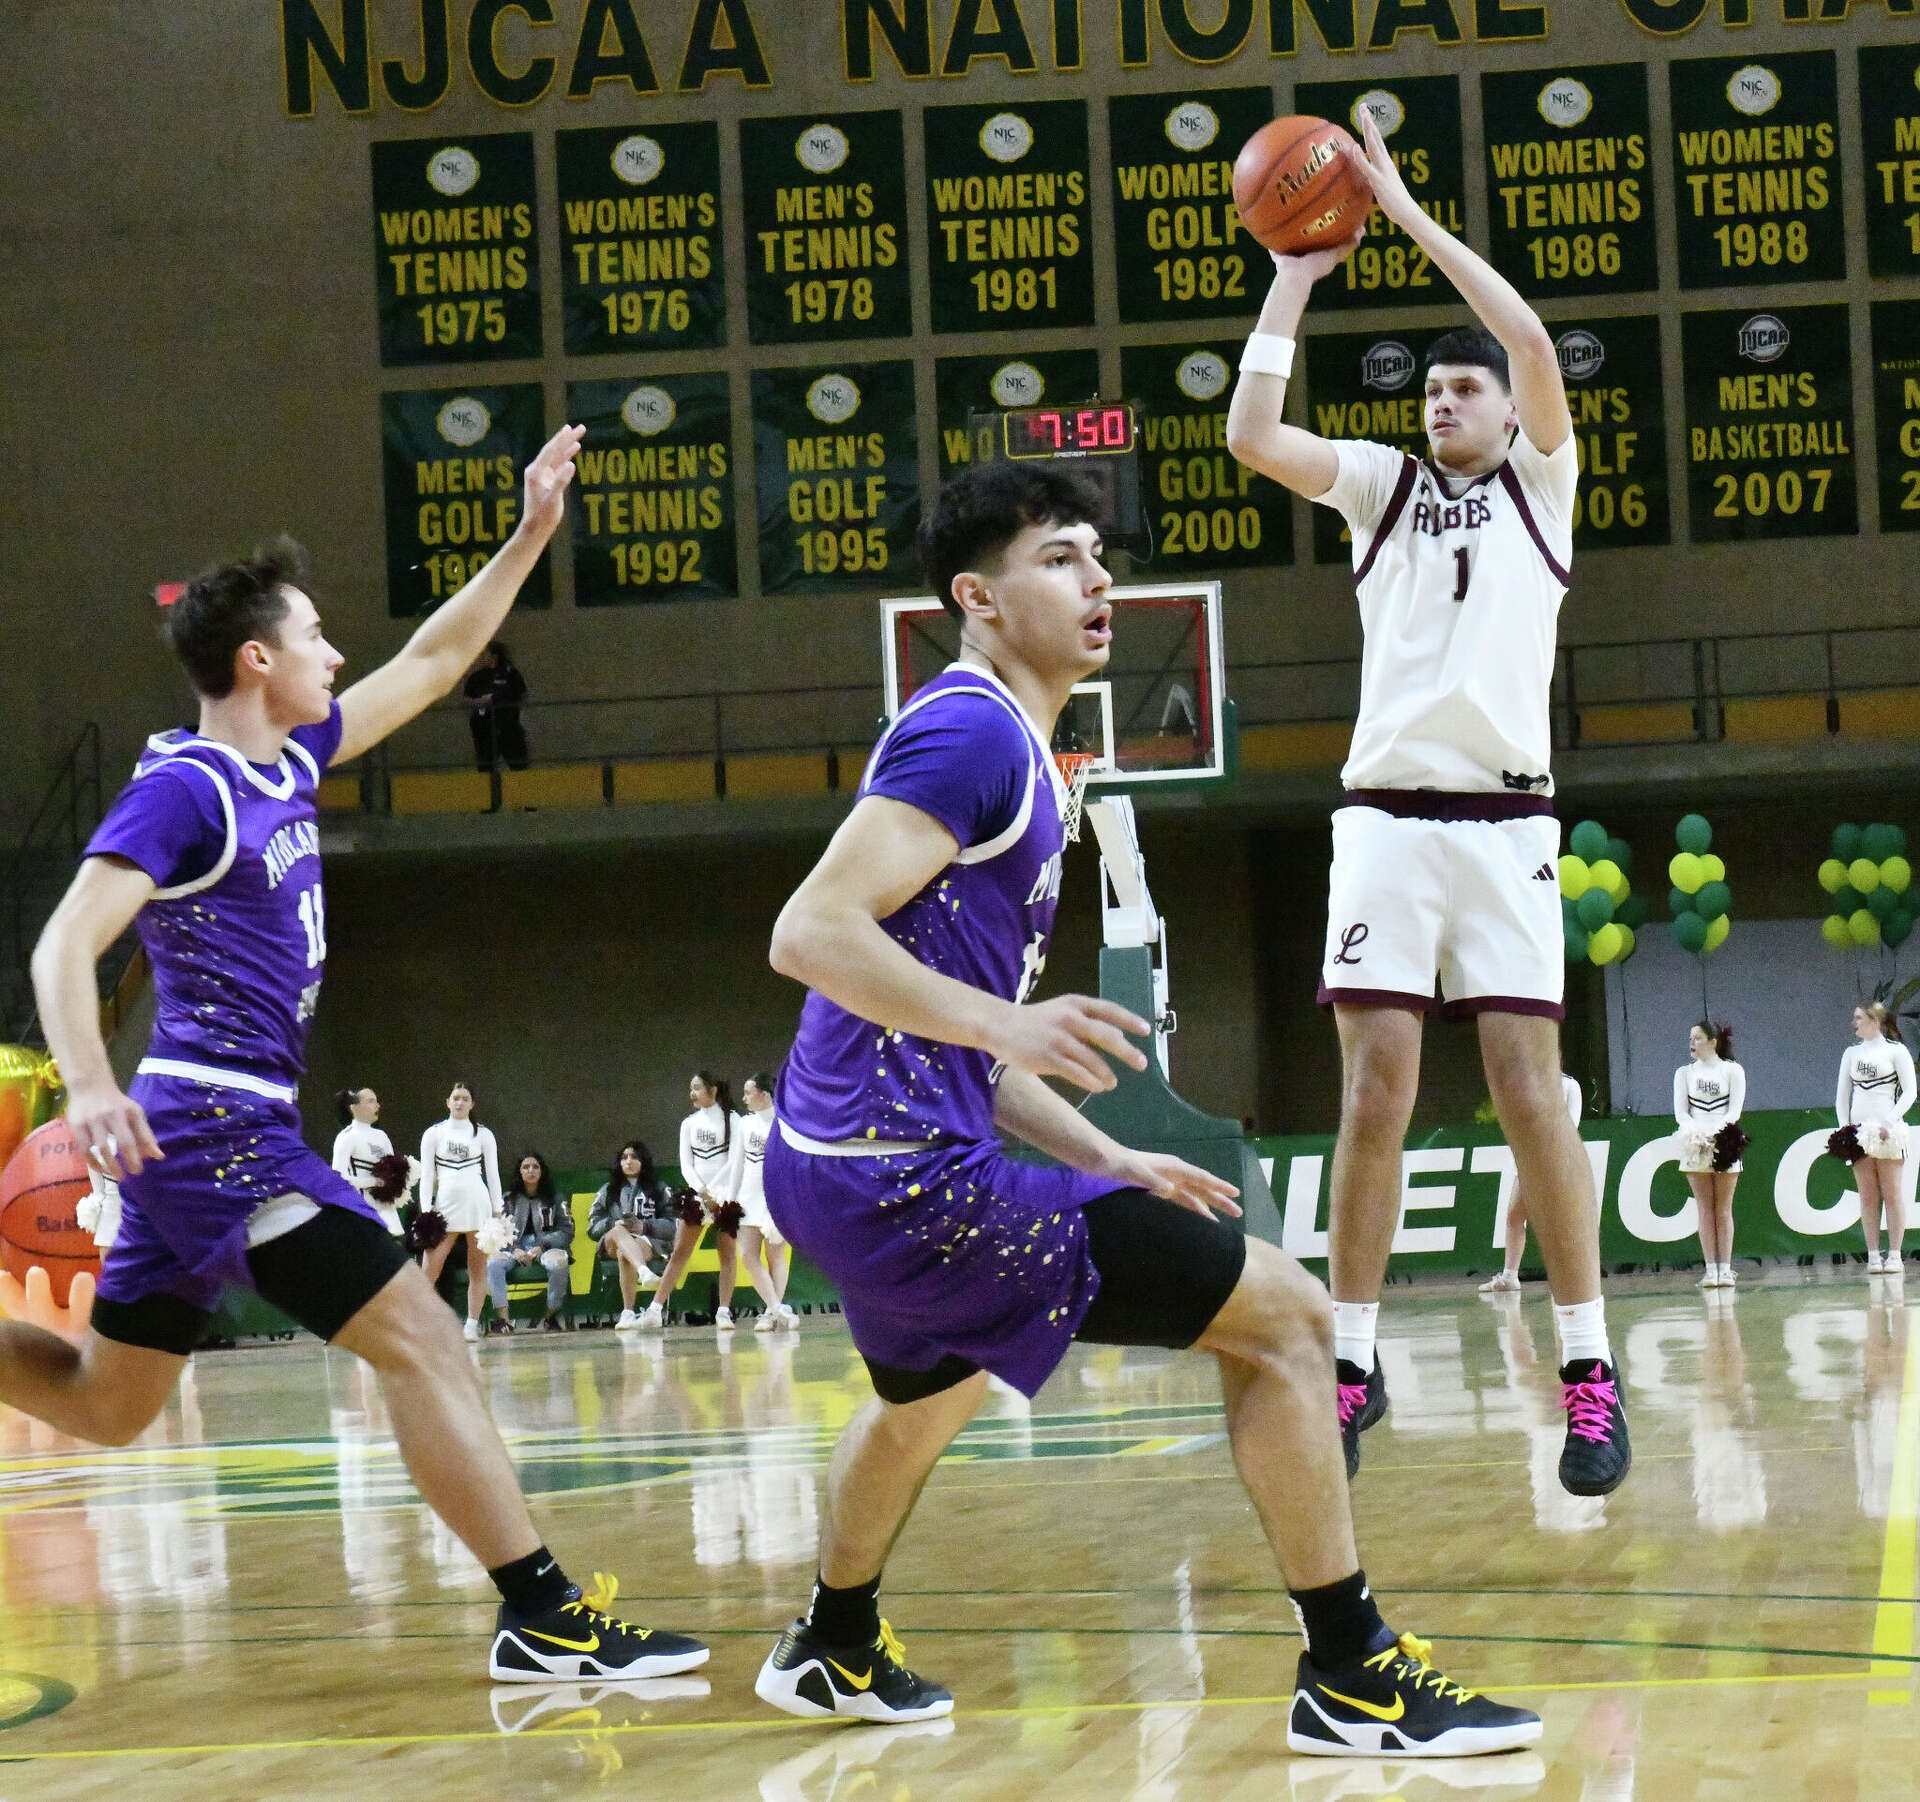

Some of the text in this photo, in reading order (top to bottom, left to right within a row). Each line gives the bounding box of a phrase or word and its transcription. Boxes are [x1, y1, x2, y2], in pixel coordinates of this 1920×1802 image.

[281, 0, 773, 118] NJCAA
[1491, 134, 1646, 178] WOMEN'S
[1679, 122, 1835, 167] WOMEN'S
[776, 182, 874, 222] MEN'S
[933, 171, 1085, 212] WOMEN'S
[1118, 162, 1236, 200] WOMEN
[1499, 178, 1642, 229] TENNIS
[1686, 166, 1830, 217] TENNIS
[380, 203, 532, 246] WOMEN'S
[565, 192, 716, 234] WOMEN'S
[572, 236, 712, 285] TENNIS
[758, 223, 897, 273] TENNIS
[940, 214, 1080, 263] TENNIS
[1527, 233, 1621, 280] 1986
[1713, 221, 1809, 267] 1988
[389, 247, 528, 296] TENNIS
[970, 267, 1057, 312] 1981
[1154, 255, 1246, 301] 1982
[1345, 248, 1432, 290] 1982
[417, 299, 506, 345] 1975
[602, 289, 690, 334] 1976
[785, 277, 874, 324] 1978
[1568, 387, 1632, 425] EN'S
[1718, 372, 1817, 412] MEN'S
[1316, 399, 1426, 439] WOME
[1691, 420, 1850, 462] BASKETBALL
[575, 443, 727, 485] WOMEN'S
[786, 432, 886, 472] MEN'S
[1577, 432, 1638, 477] LF
[416, 456, 515, 495] MEN'S
[1712, 469, 1833, 518] 2007
[583, 486, 723, 536] TENNIS
[788, 475, 887, 523] GOLF
[1573, 483, 1648, 531] 06
[418, 499, 517, 546] GOLF
[1160, 506, 1262, 554] 2000
[424, 551, 491, 597] 19
[610, 540, 702, 586] 1992
[796, 528, 889, 574] 1995
[1453, 546, 1469, 602] 1
[1333, 922, 1369, 965] L
[1258, 1133, 1700, 1259] LETIC
